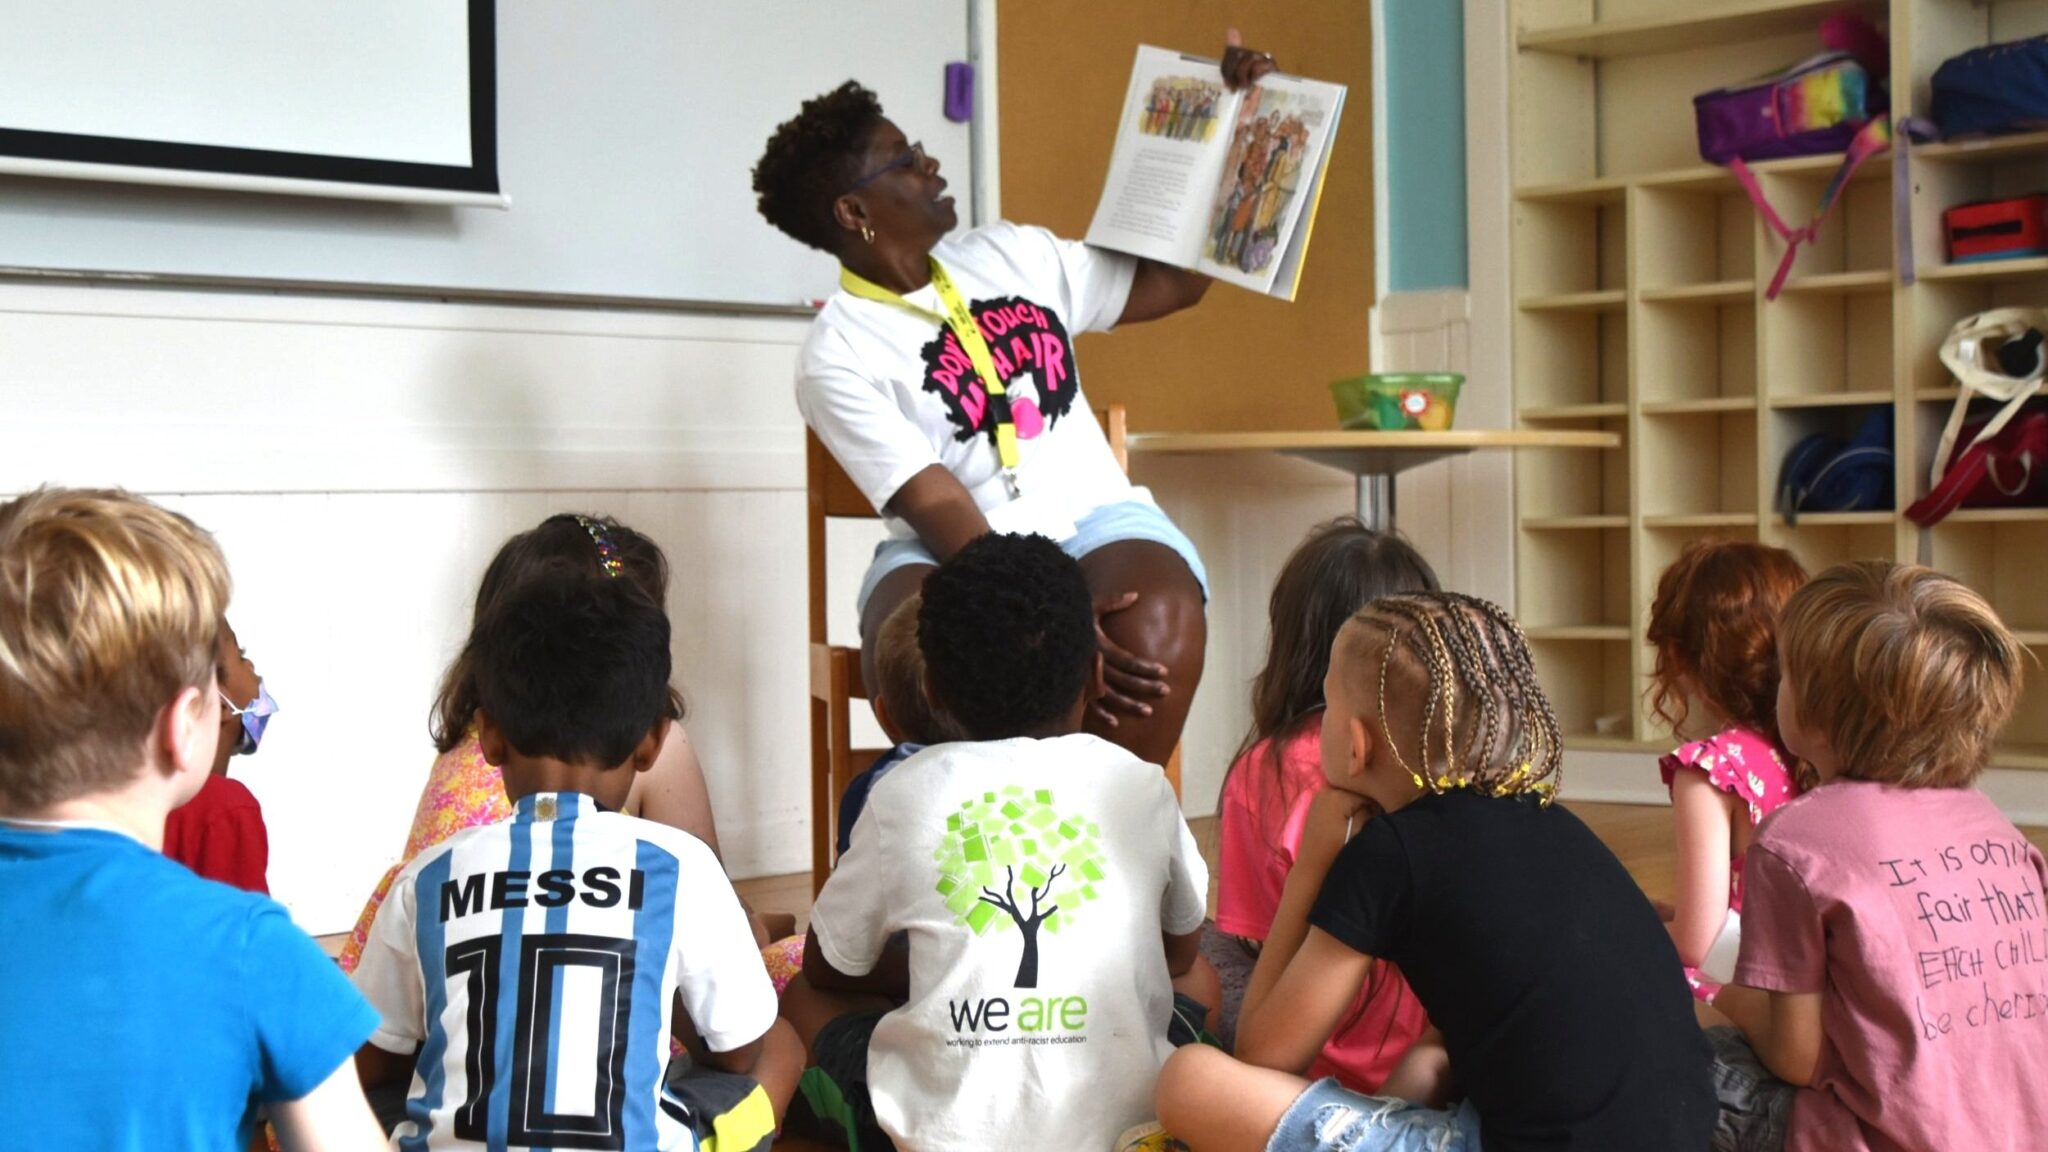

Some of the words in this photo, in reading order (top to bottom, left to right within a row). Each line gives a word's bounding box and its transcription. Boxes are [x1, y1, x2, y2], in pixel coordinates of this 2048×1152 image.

[992, 332, 1067, 391] HAIR
[1878, 858, 1927, 887] It
[1938, 845, 1963, 873] is
[1970, 839, 2030, 868] only
[439, 866, 645, 923] MESSI
[1916, 891, 1972, 943] fair
[1918, 946, 1984, 989] EACH
[949, 997, 1010, 1033] we
[1016, 996, 1088, 1032] are
[1916, 996, 1951, 1041] be
[445, 933, 638, 1151] 10
[945, 1037, 974, 1048] working
[983, 1037, 1010, 1047] extend
[1011, 1036, 1049, 1046] anti-racist
[1050, 1035, 1087, 1045] education
